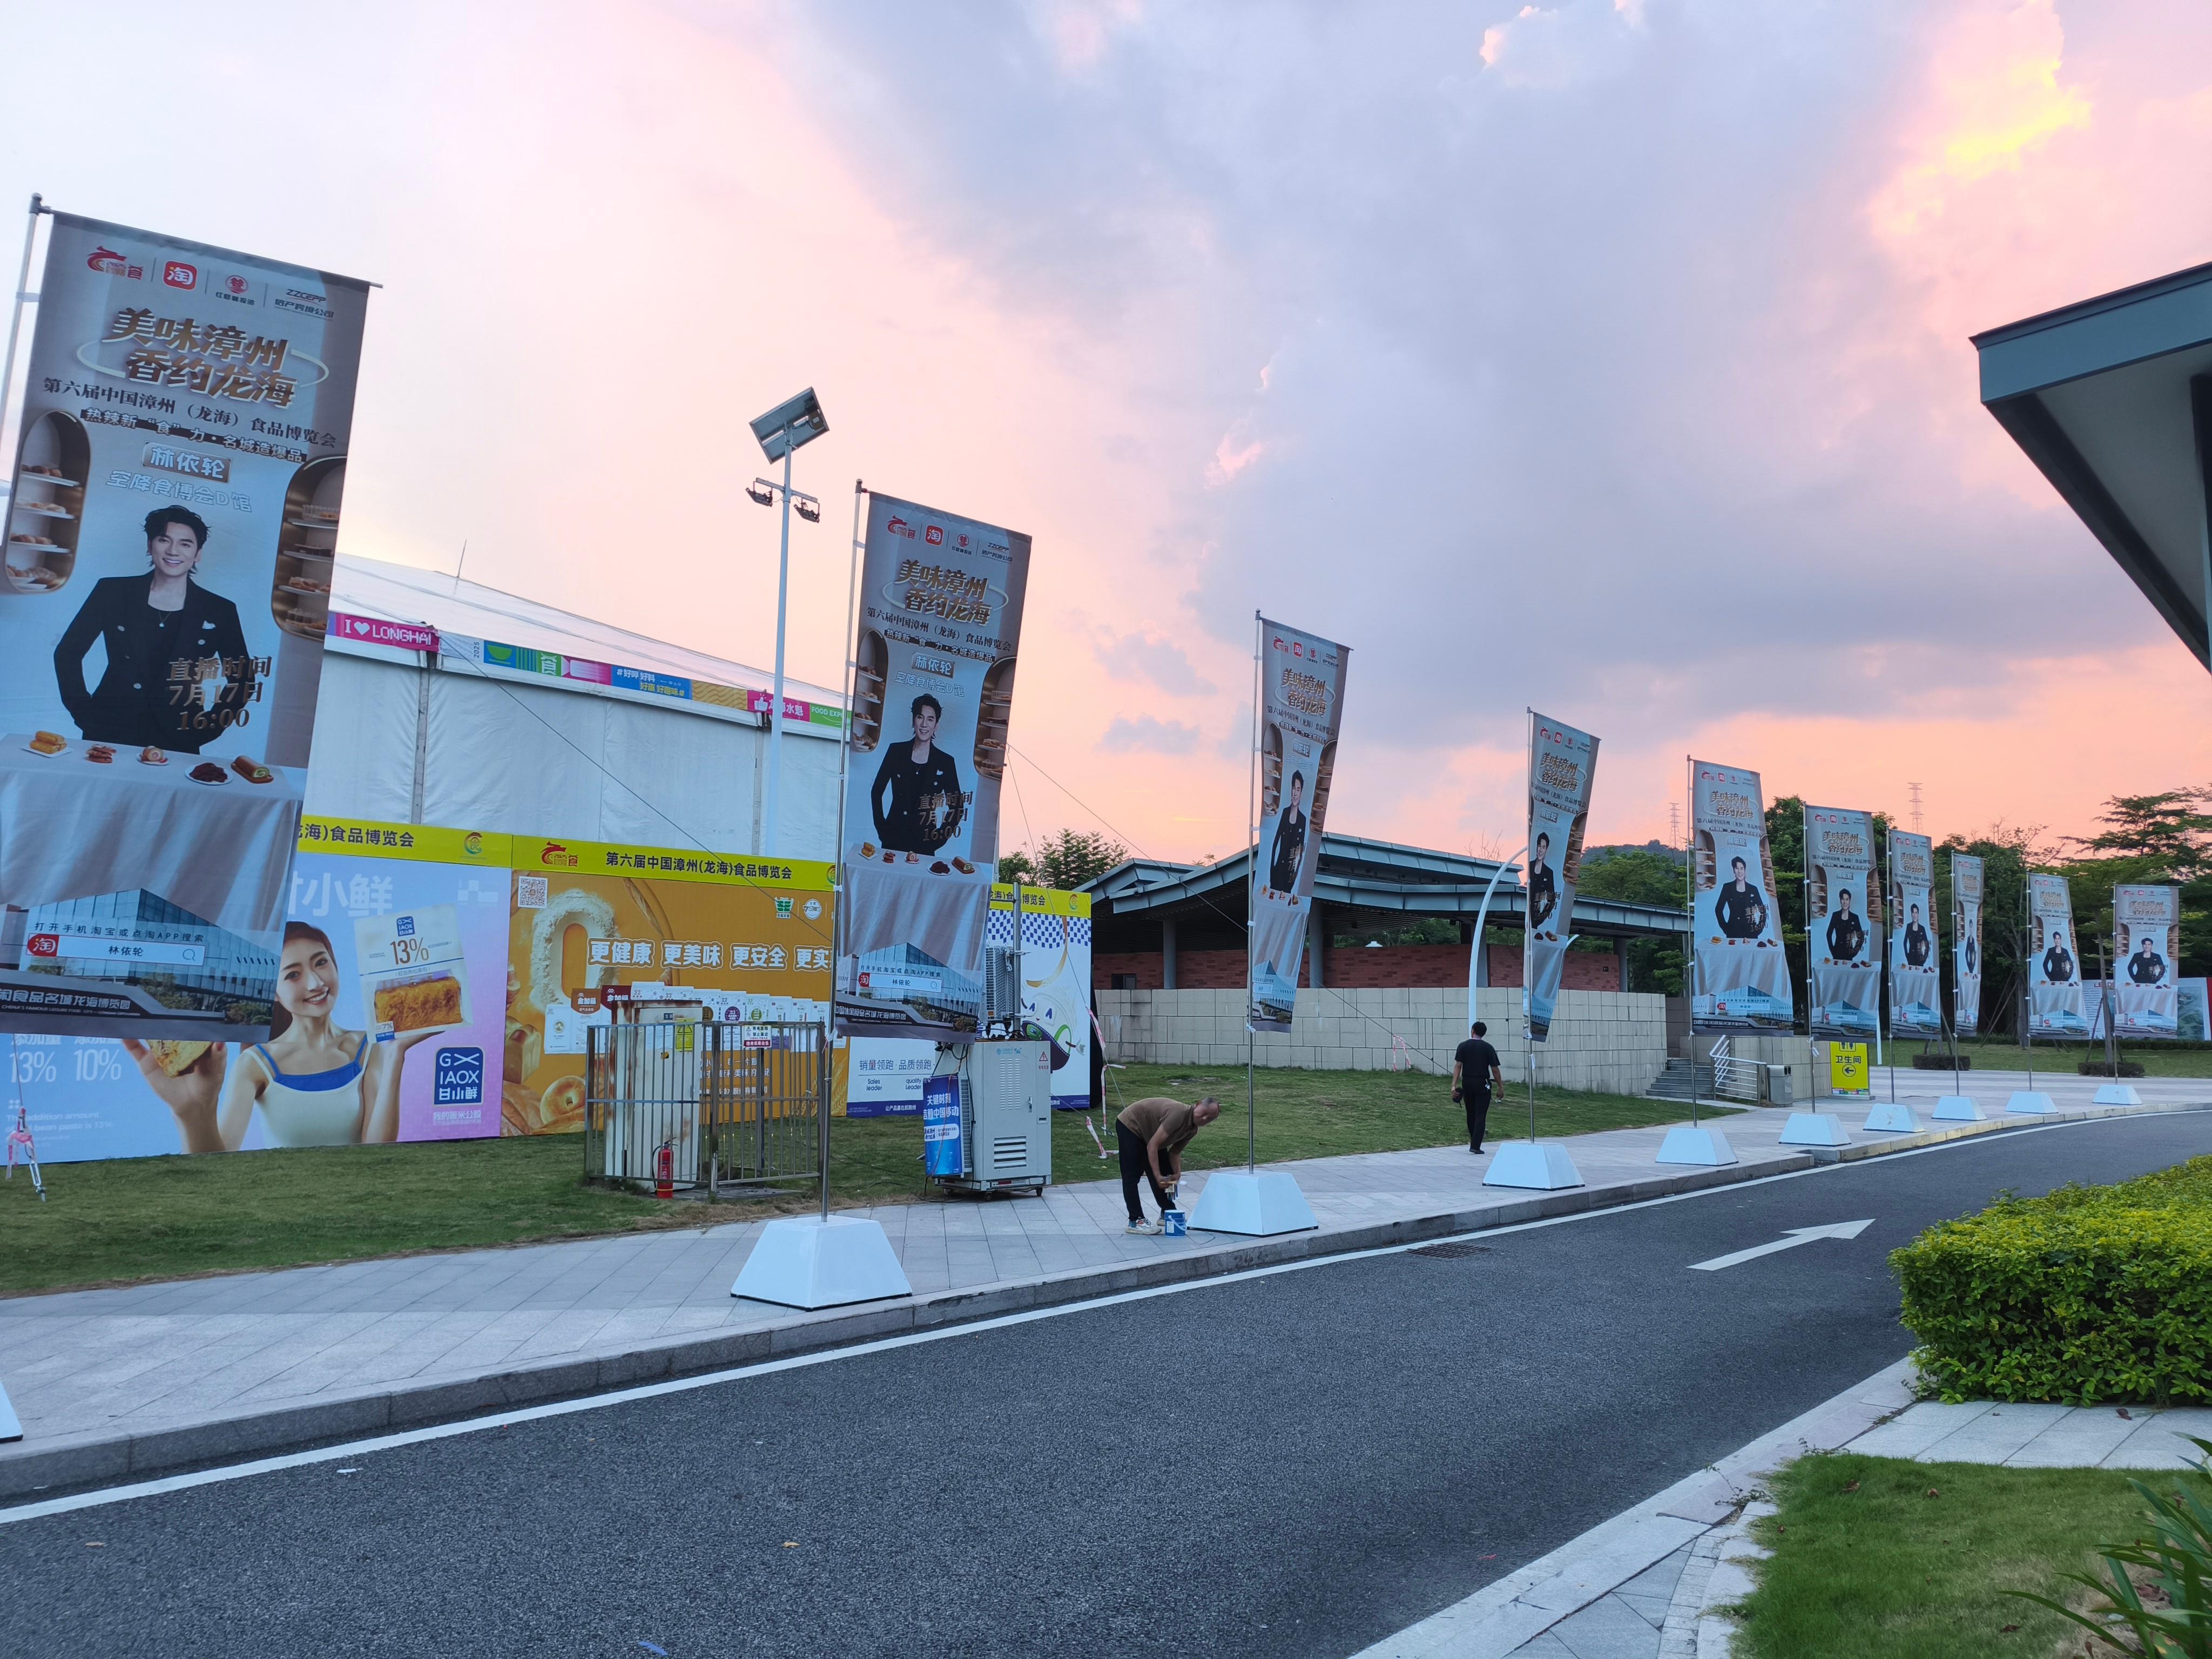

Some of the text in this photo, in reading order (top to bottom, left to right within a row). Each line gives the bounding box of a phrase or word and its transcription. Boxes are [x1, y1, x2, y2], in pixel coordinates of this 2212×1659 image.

[166, 267, 193, 285] 淘
[102, 306, 291, 373] 美味漳州
[125, 347, 299, 409] 香约龙海
[150, 446, 226, 479] 林依轮
[106, 469, 252, 513] 空降食博会D馆
[894, 559, 988, 601] 美味漳州
[905, 588, 992, 626] 香约龙海
[373, 623, 433, 646] LONGHAI
[166, 655, 272, 681] 直播时间
[915, 655, 952, 675] 林依轮
[168, 680, 263, 706] 7月17日
[895, 672, 965, 697] 空降食博会D馆
[1281, 668, 1326, 698] 美味漳州
[812, 706, 828, 715] FOOD
[1287, 691, 1327, 717] 香约龙海
[177, 709, 251, 730] 16:00
[1539, 752, 1578, 776] 美味漳州
[1542, 770, 1579, 793] 香约龙海
[918, 791, 973, 810] 直播时间
[1710, 791, 1750, 807] 美味漳州
[919, 808, 968, 825] 7月17日
[1716, 804, 1754, 820] 香约龙海
[923, 826, 961, 841] 16:00
[1822, 831, 1858, 844] 美味漳州
[606, 852, 792, 880] 第六届中国漳州(龙海)食品博览会
[35, 922, 204, 942] 打开手机淘宝或点淘APP搜索
[33, 938, 56, 953] 淘
[108, 946, 144, 956] 林依轮
[390, 937, 429, 965] 13%
[591, 941, 833, 968] 更健康 更美味 更安全 更实
[9, 1049, 122, 1083] 13% 10%
[859, 1059, 932, 1070] 销量领跑 品质领跑
[1835, 1055, 1862, 1064] 卫生间
[440, 1070, 480, 1084] IAOX
[927, 1092, 951, 1105] 关键时刻
[59, 1123, 83, 1132] paste
